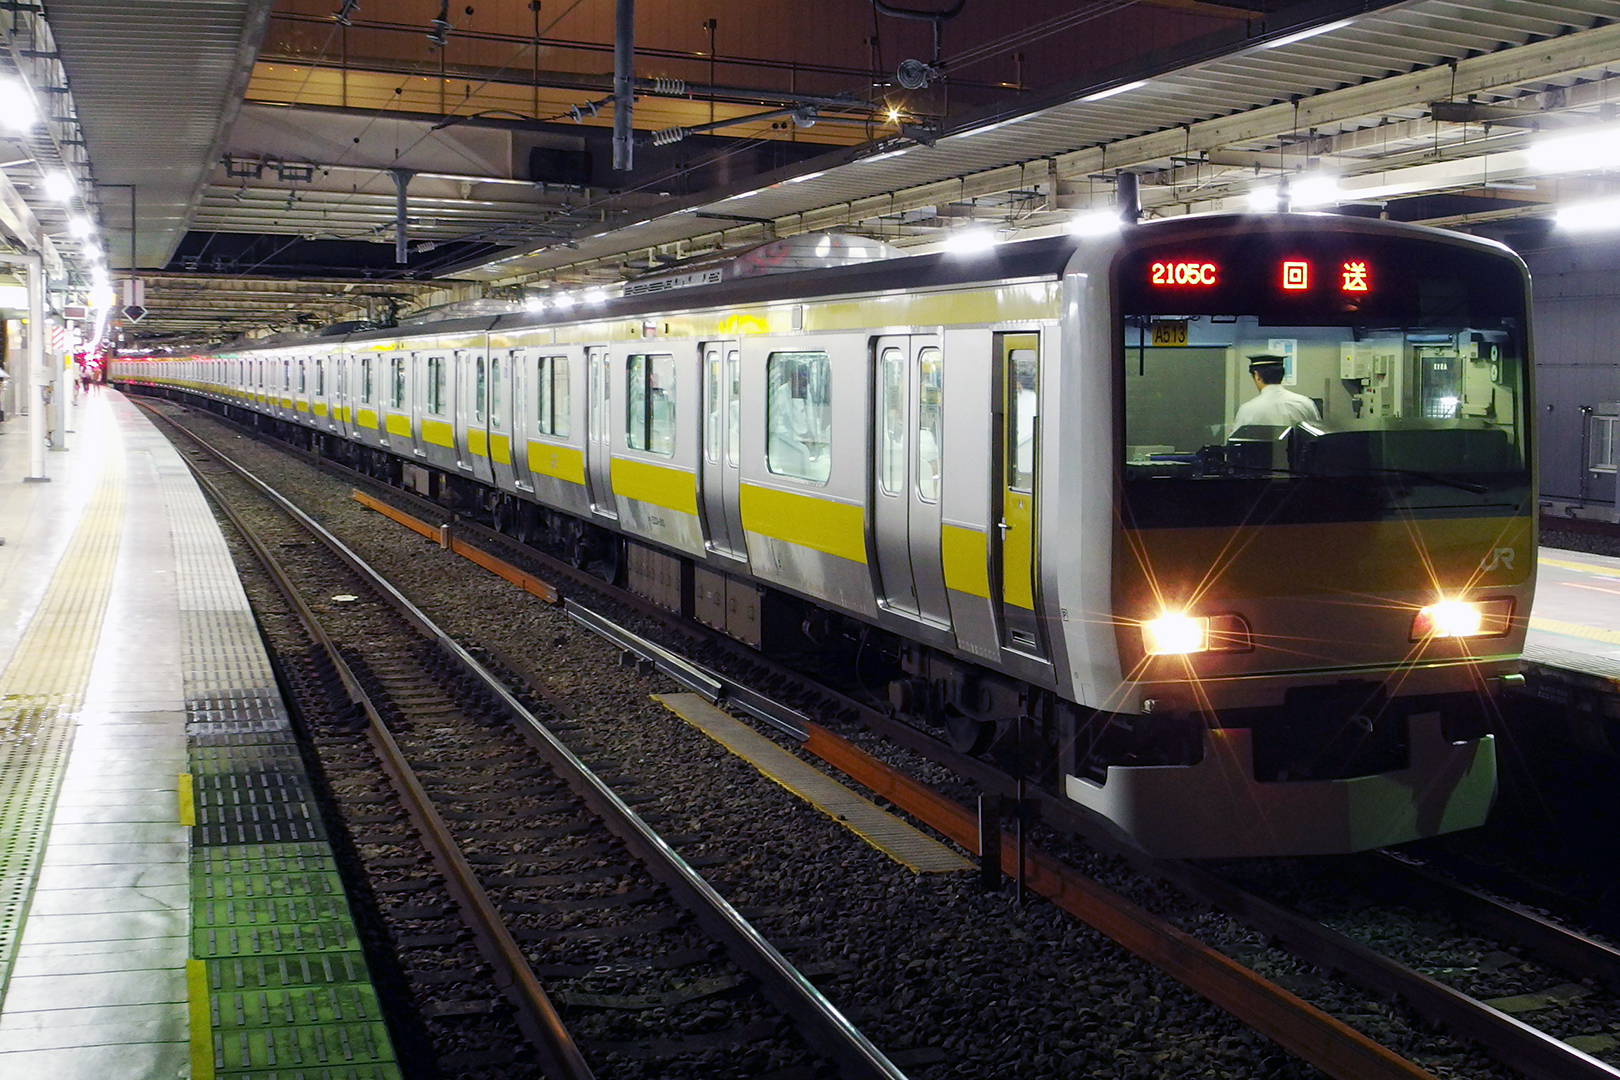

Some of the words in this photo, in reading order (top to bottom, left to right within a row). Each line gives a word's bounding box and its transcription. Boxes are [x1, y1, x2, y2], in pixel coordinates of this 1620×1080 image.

[1151, 262, 1216, 285] 2105C
[1154, 325, 1186, 343] A513
[1480, 547, 1515, 571] JR
